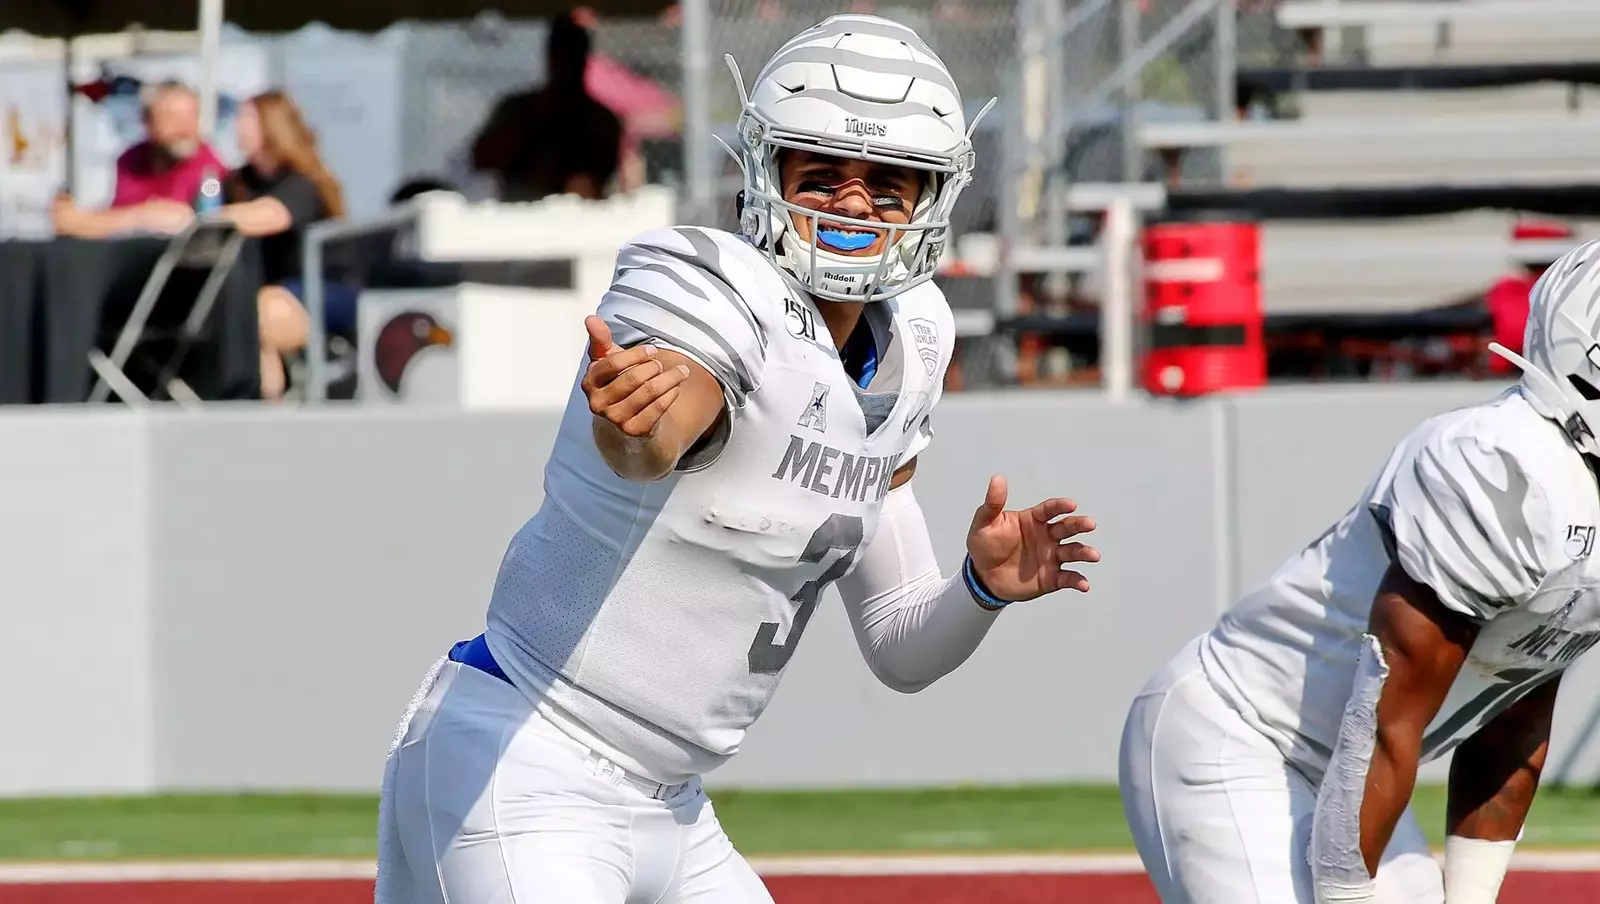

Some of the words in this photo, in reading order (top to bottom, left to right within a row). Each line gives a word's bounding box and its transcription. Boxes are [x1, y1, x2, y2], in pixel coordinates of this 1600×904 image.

[845, 118, 887, 137] Tigers
[824, 271, 855, 283] Riddell
[783, 297, 816, 341] 150
[1564, 524, 1597, 562] 150
[748, 512, 864, 676] 3
